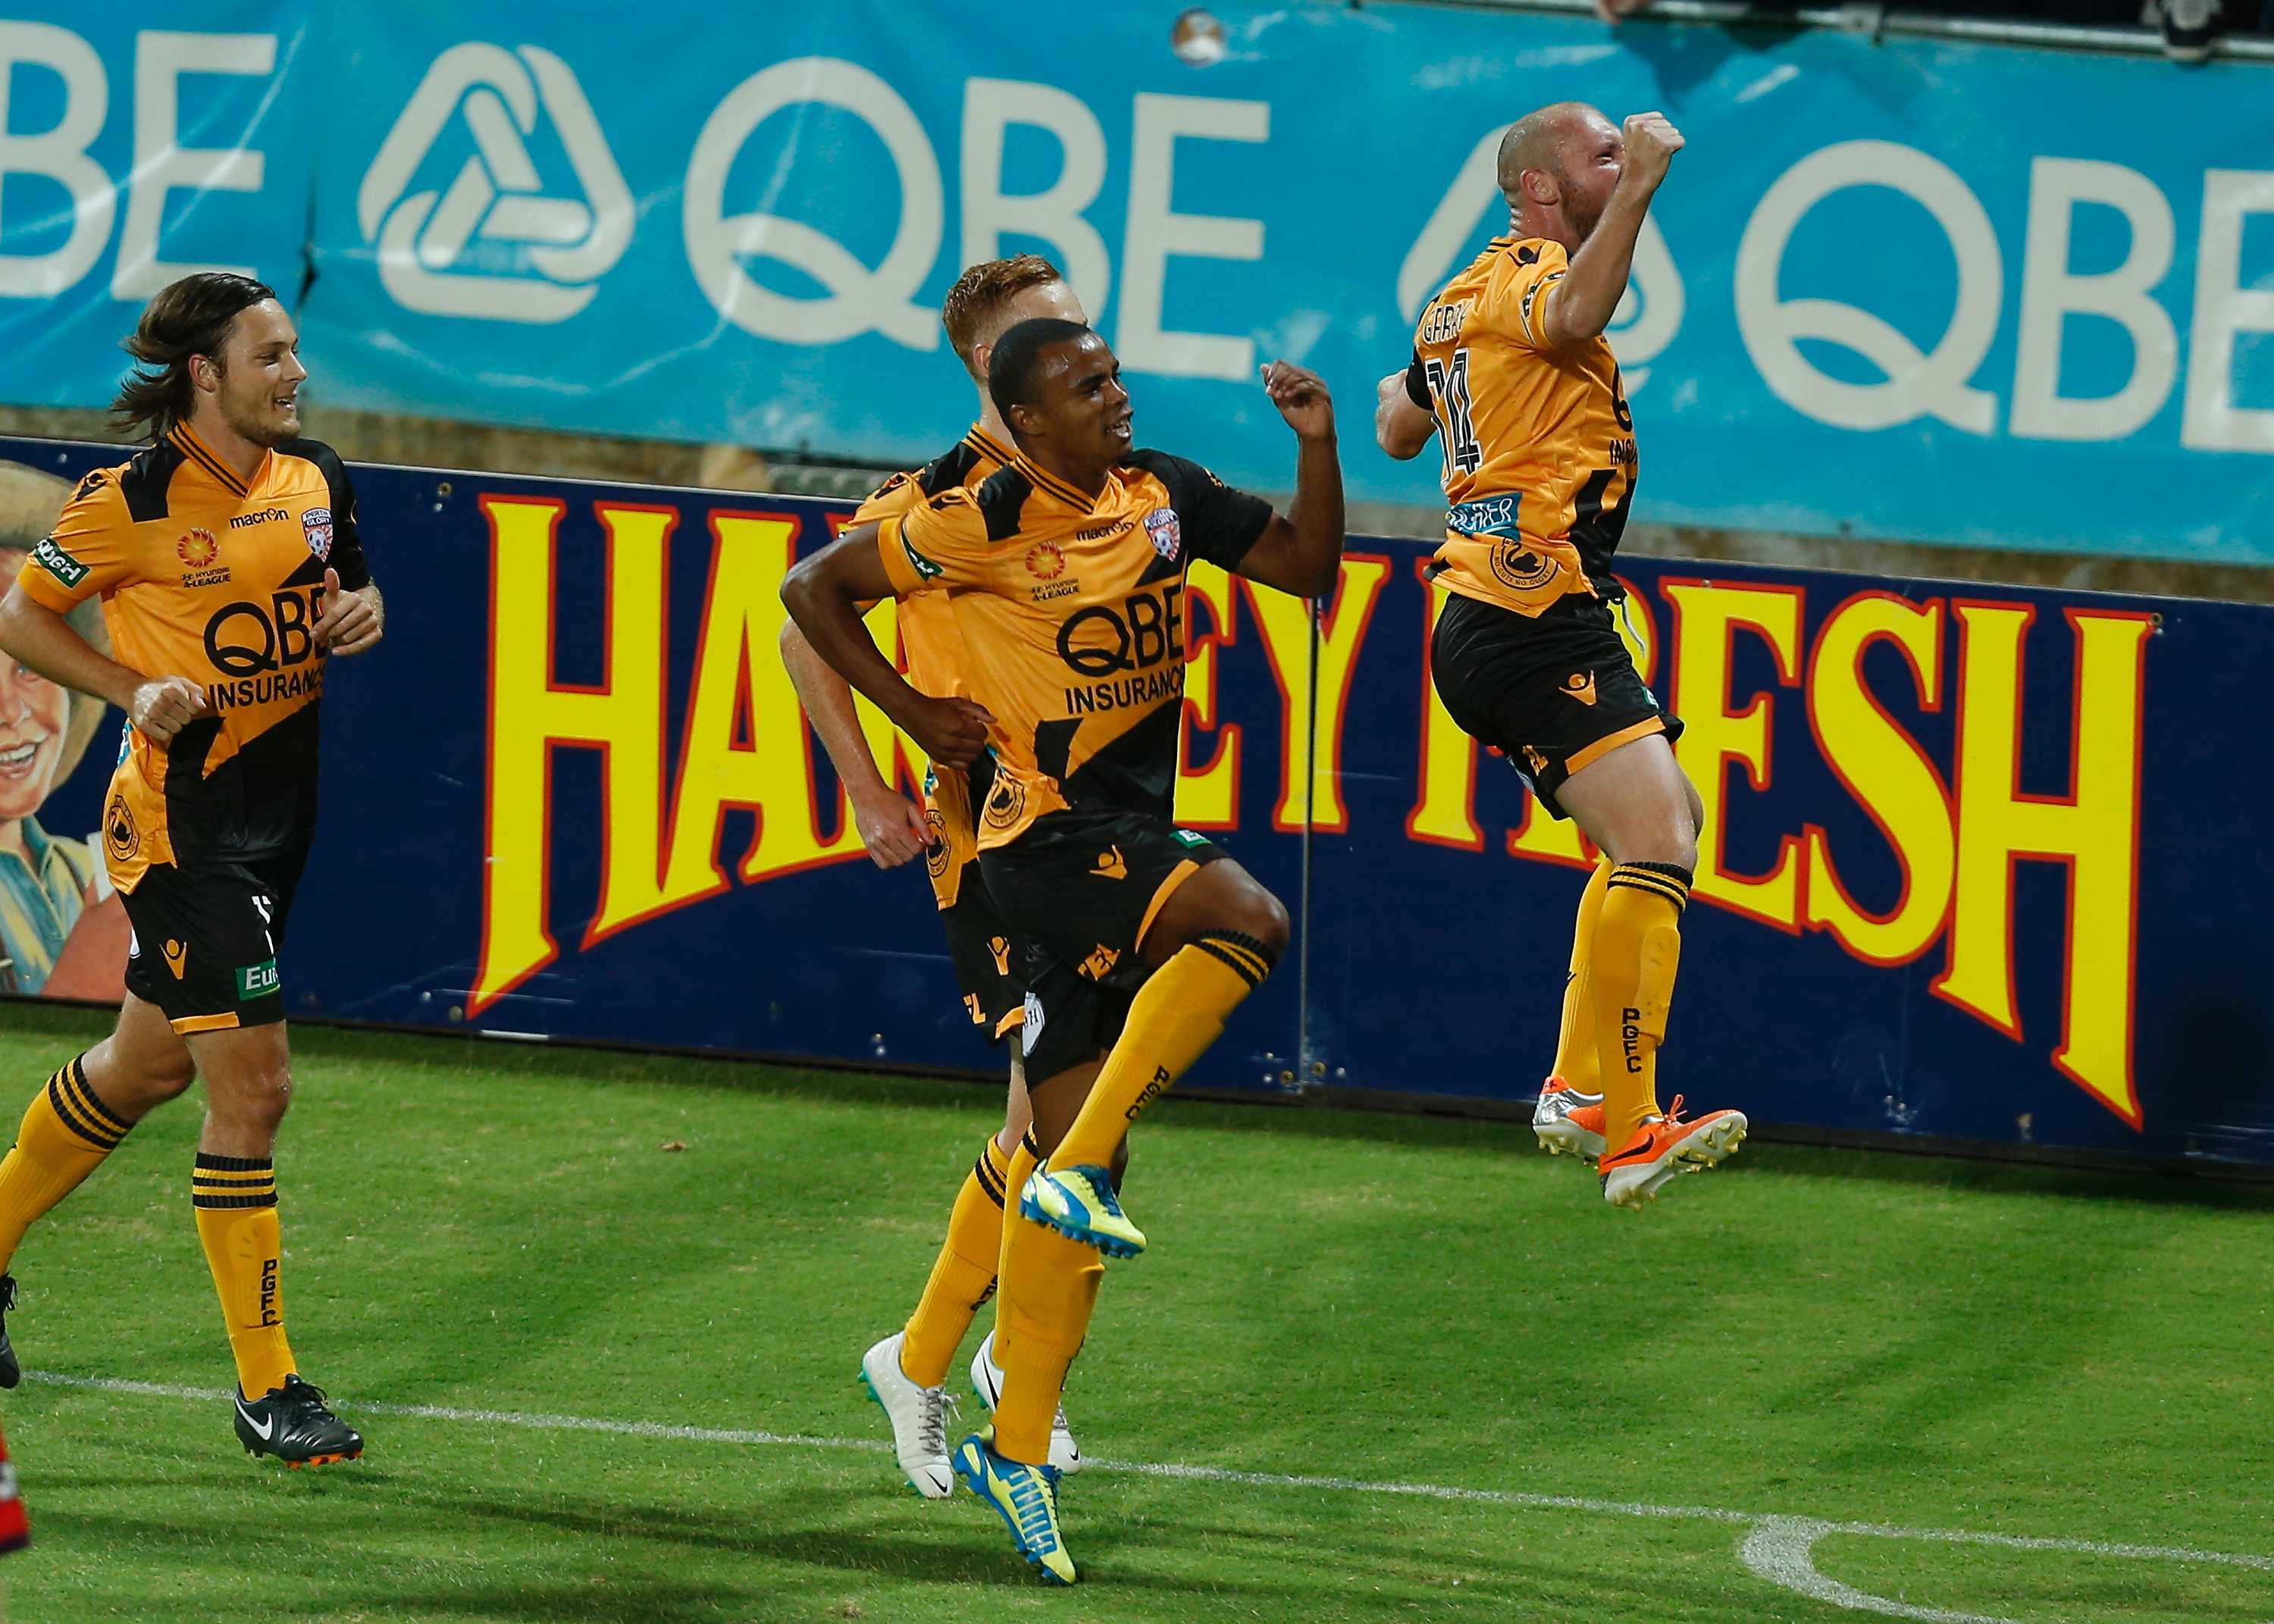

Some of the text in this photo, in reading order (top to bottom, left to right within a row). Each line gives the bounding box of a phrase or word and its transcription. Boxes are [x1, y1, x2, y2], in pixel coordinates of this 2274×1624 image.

[682, 55, 1270, 380] QBE
[1734, 139, 2274, 454] QBE
[230, 508, 290, 529] macron
[183, 574, 231, 589] A-LEAGUE
[1032, 584, 1080, 601] A-LEAGUE
[204, 587, 327, 677] QBE
[1056, 582, 1185, 677] QBE
[465, 492, 1393, 1021] HAEY
[1622, 1007, 1643, 1073] PGFC
[261, 1259, 278, 1326] PGFC
